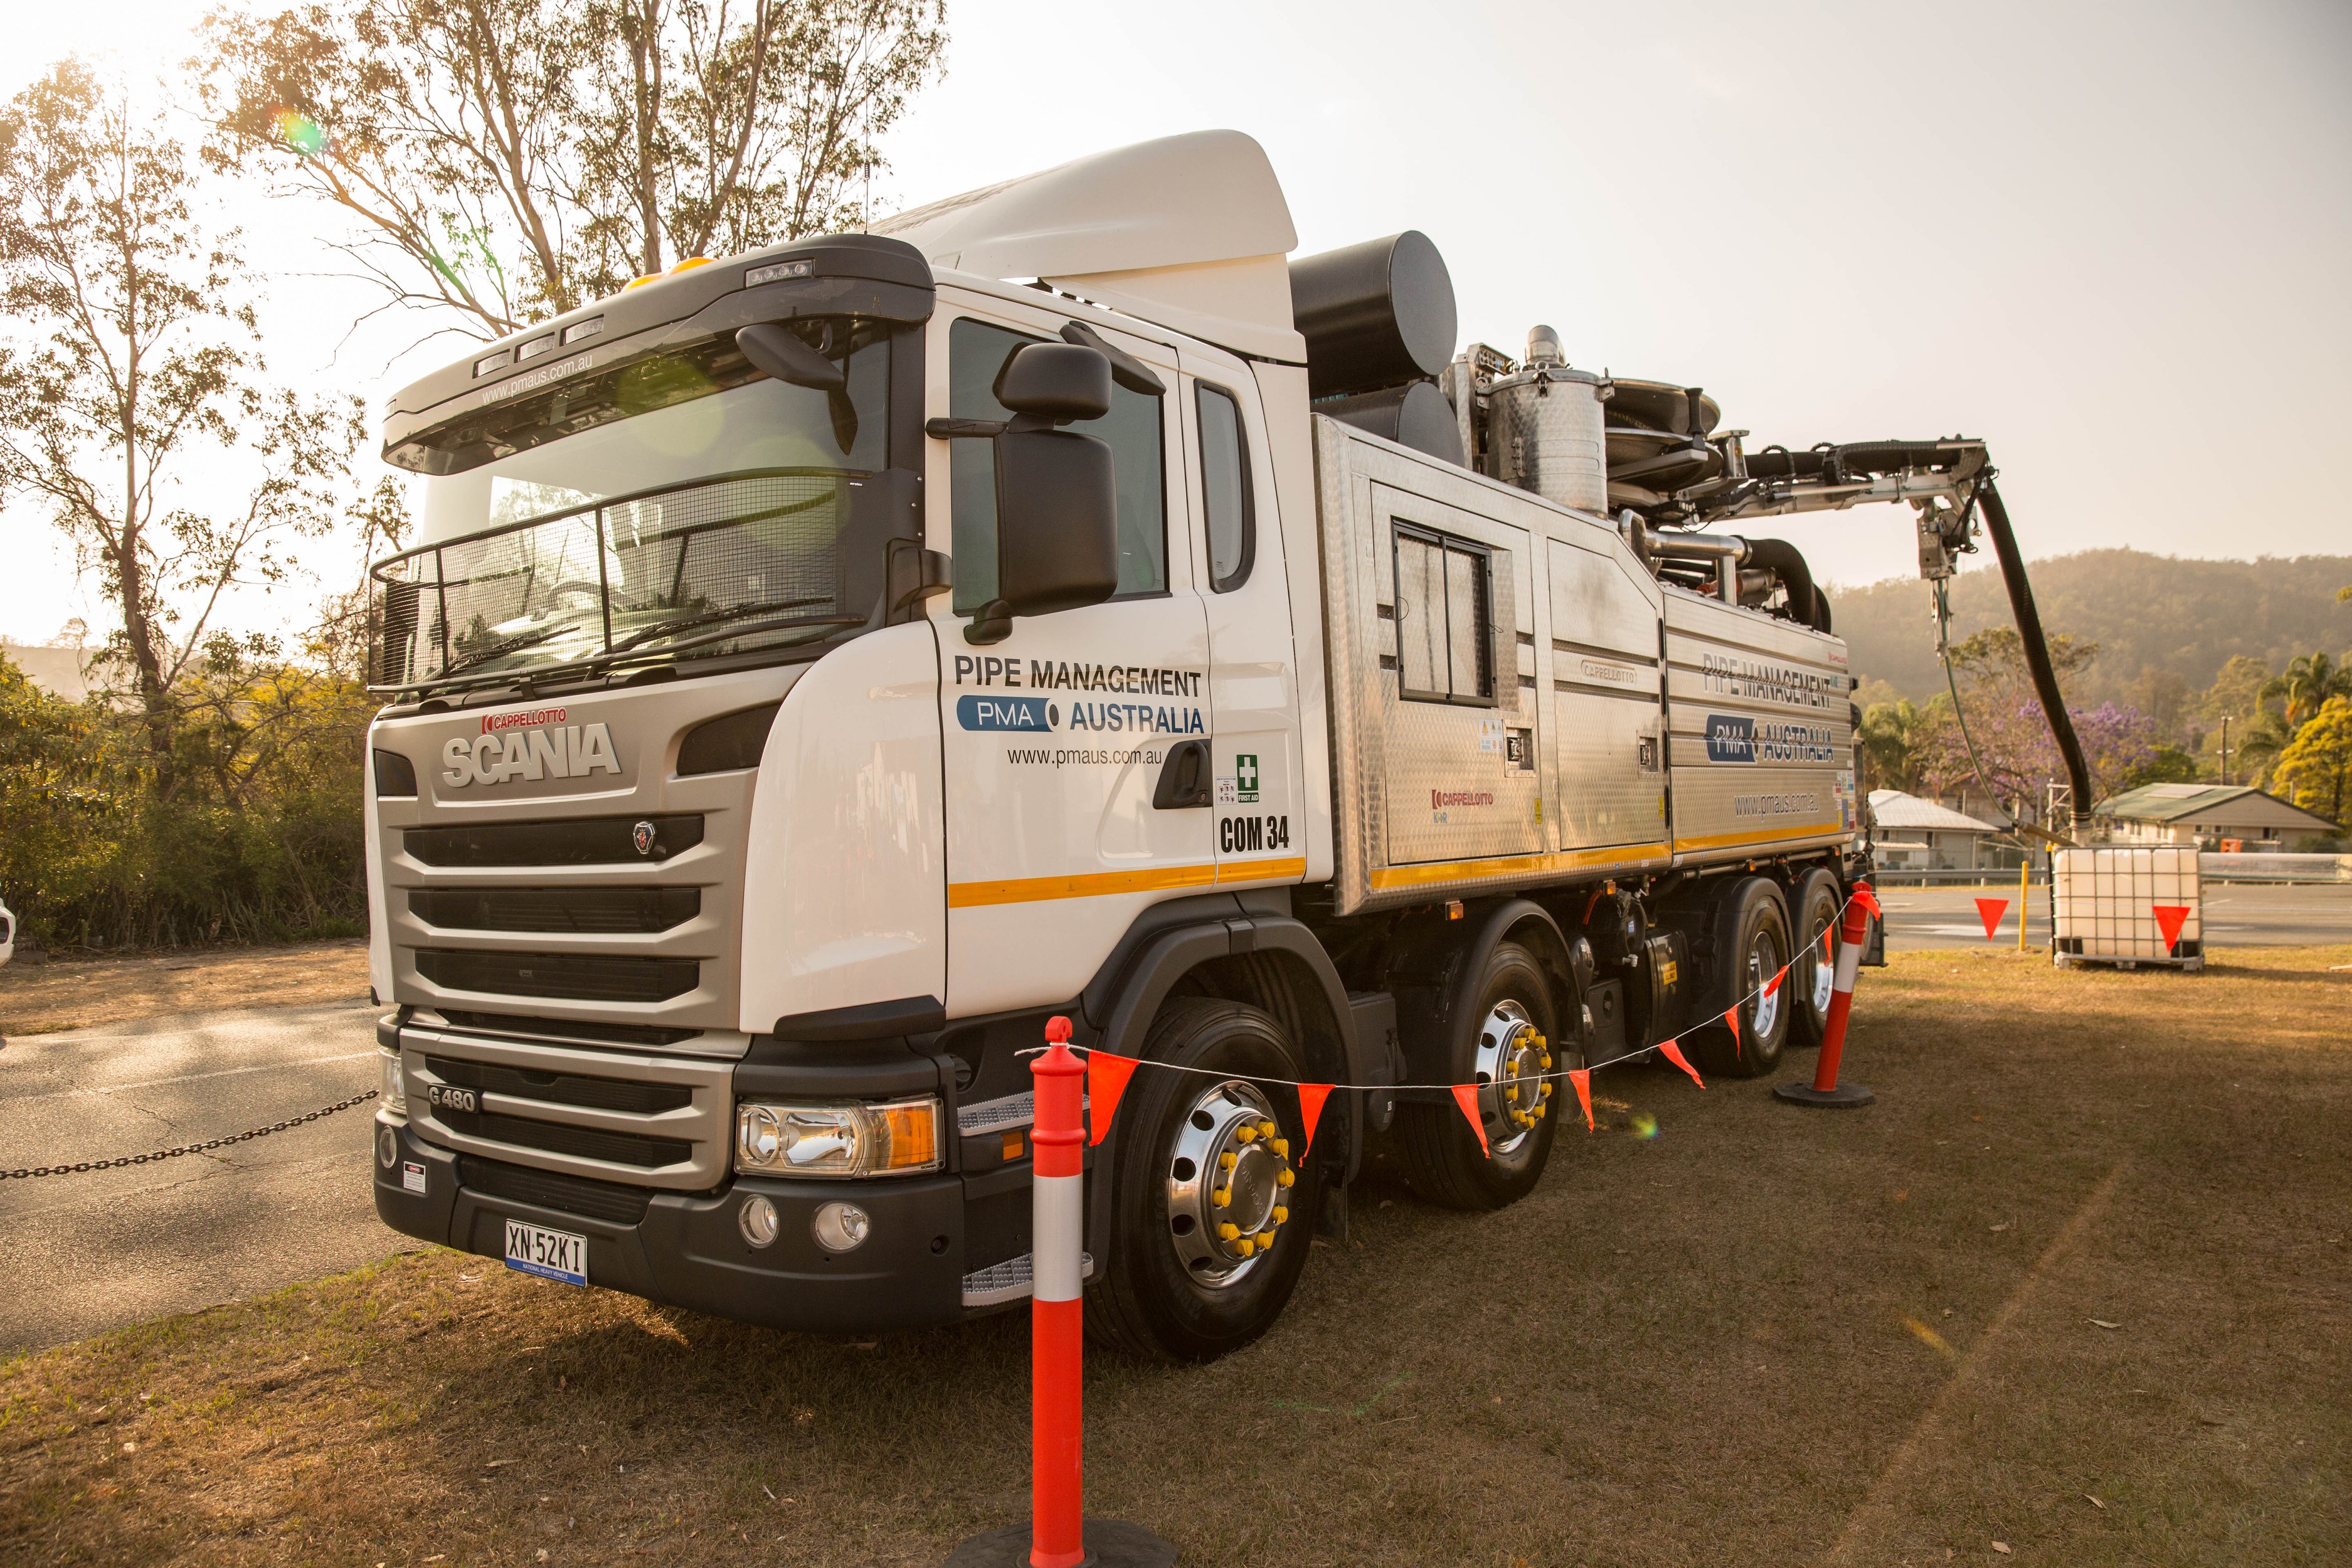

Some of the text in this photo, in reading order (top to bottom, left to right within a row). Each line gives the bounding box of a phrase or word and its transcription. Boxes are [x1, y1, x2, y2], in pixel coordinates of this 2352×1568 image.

[482, 355, 592, 403] www.pmaus.com.au
[955, 655, 1201, 697] PIPE MANAGEMENT
[1584, 665, 1634, 683] CAPPELLOTTO
[1703, 653, 1831, 709] PIPE MANAGEMENT
[494, 707, 567, 730] CAPPELLOTTO
[977, 702, 1204, 734] PMA AUSTRALIA
[442, 723, 622, 788] SCANIA
[1715, 723, 1835, 763] PMA AUSTRALIA
[1007, 750, 1162, 769] www.pmaus.com.au
[1443, 792, 1494, 807] CAPPELLOTTO
[1734, 793, 1819, 822] www.pmaus.com.au
[1221, 815, 1290, 853] COM 34
[429, 1087, 475, 1112] G 480
[522, 1263, 568, 1279] NATIONAL HEAVY VEHICLE
